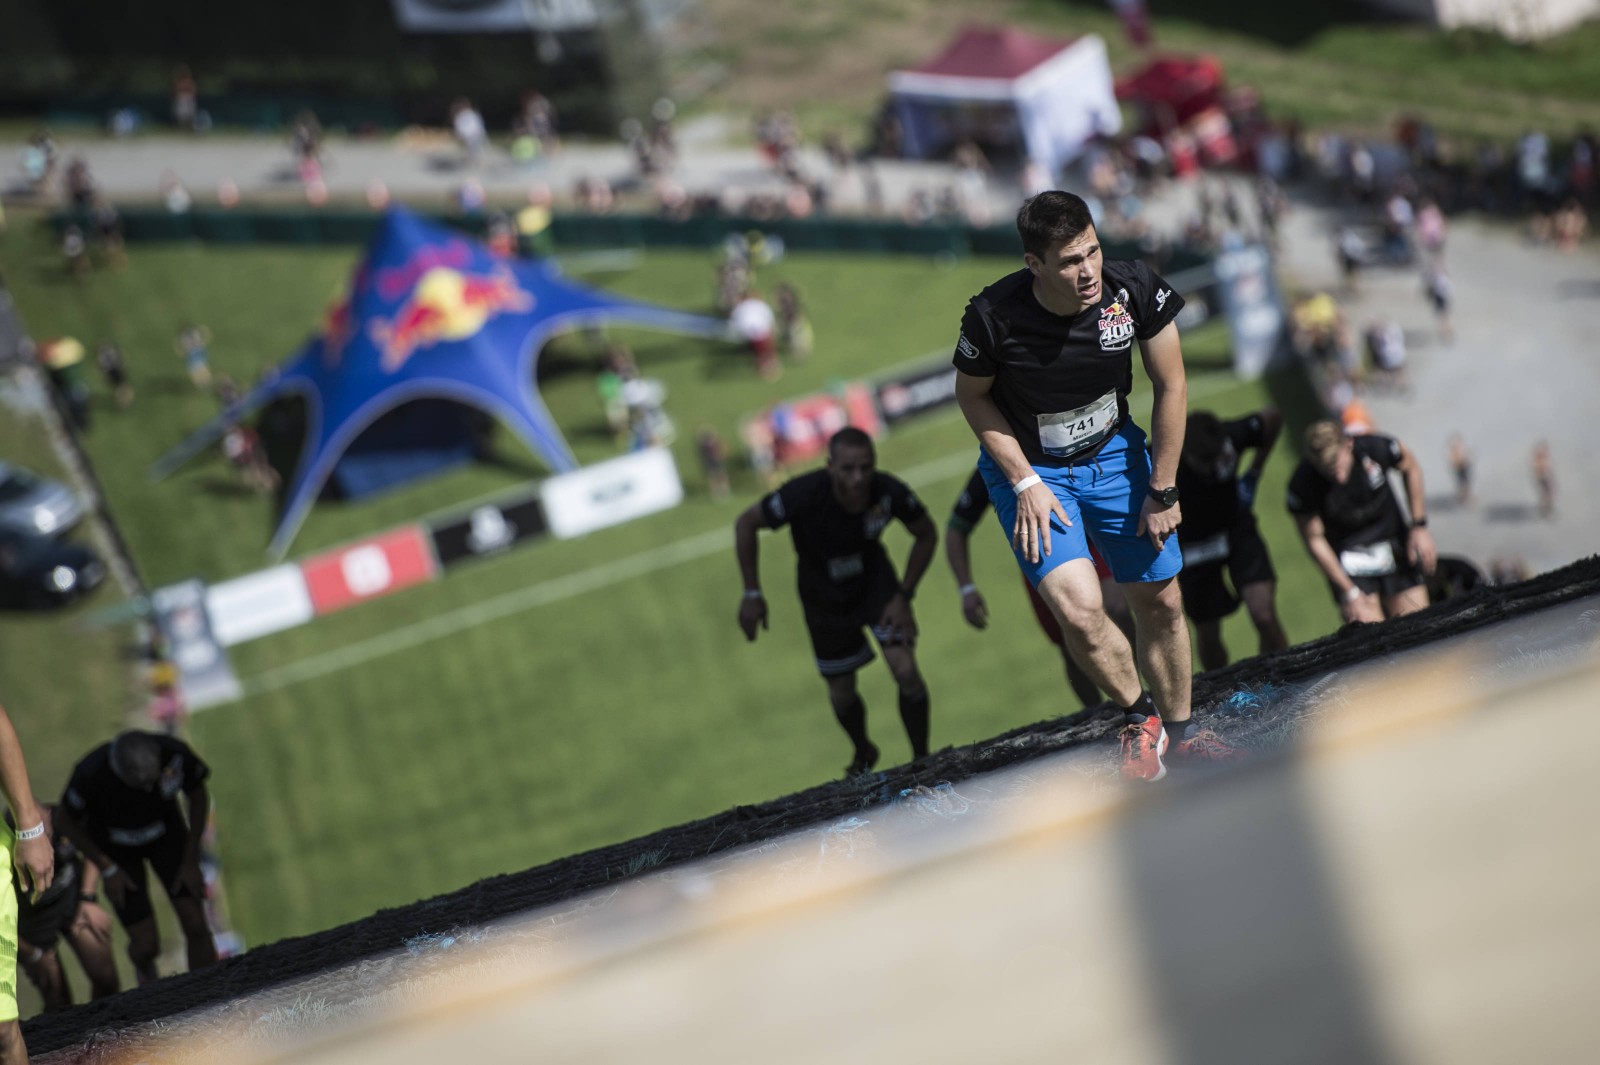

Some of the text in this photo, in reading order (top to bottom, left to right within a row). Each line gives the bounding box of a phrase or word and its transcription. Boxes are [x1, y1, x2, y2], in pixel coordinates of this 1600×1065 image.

[1099, 316, 1120, 330] Red
[1102, 324, 1133, 341] 400
[1066, 416, 1096, 436] 741
[1072, 430, 1093, 441] Martin
